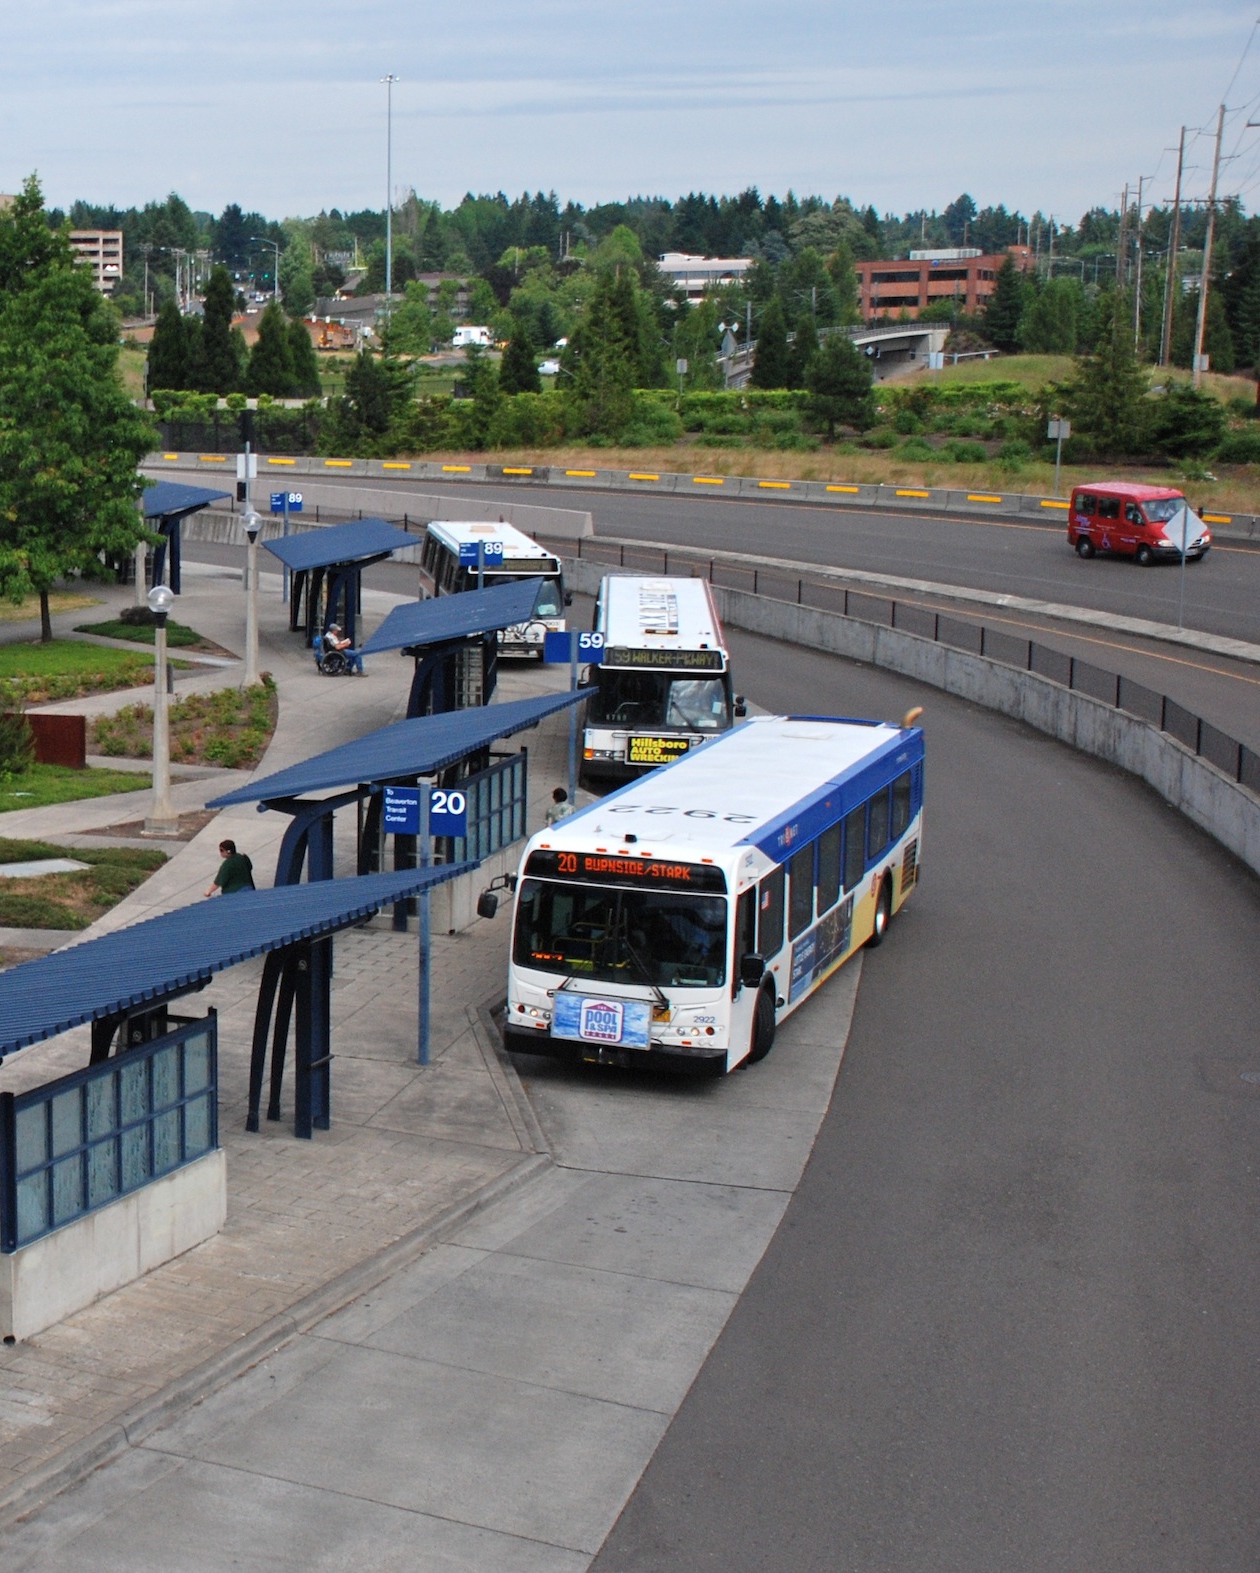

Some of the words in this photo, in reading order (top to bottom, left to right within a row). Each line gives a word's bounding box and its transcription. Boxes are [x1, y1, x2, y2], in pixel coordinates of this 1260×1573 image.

[288, 493, 302, 503] 89
[484, 543, 502, 555] 89
[579, 633, 604, 648] 59
[615, 651, 630, 663] 59
[631, 738, 687, 749] Hillsboro
[631, 747, 662, 755] AUTO
[630, 753, 679, 762] WRECKIN
[385, 797, 417, 805] Beaverton
[431, 791, 465, 815] 20
[608, 804, 758, 824] 2922
[557, 853, 577, 873] 20
[584, 857, 691, 880] BURNSIDE/STARK
[585, 1010, 617, 1029] POOL
[693, 1015, 716, 1024] 2922
[597, 1024, 617, 1033] SPA
